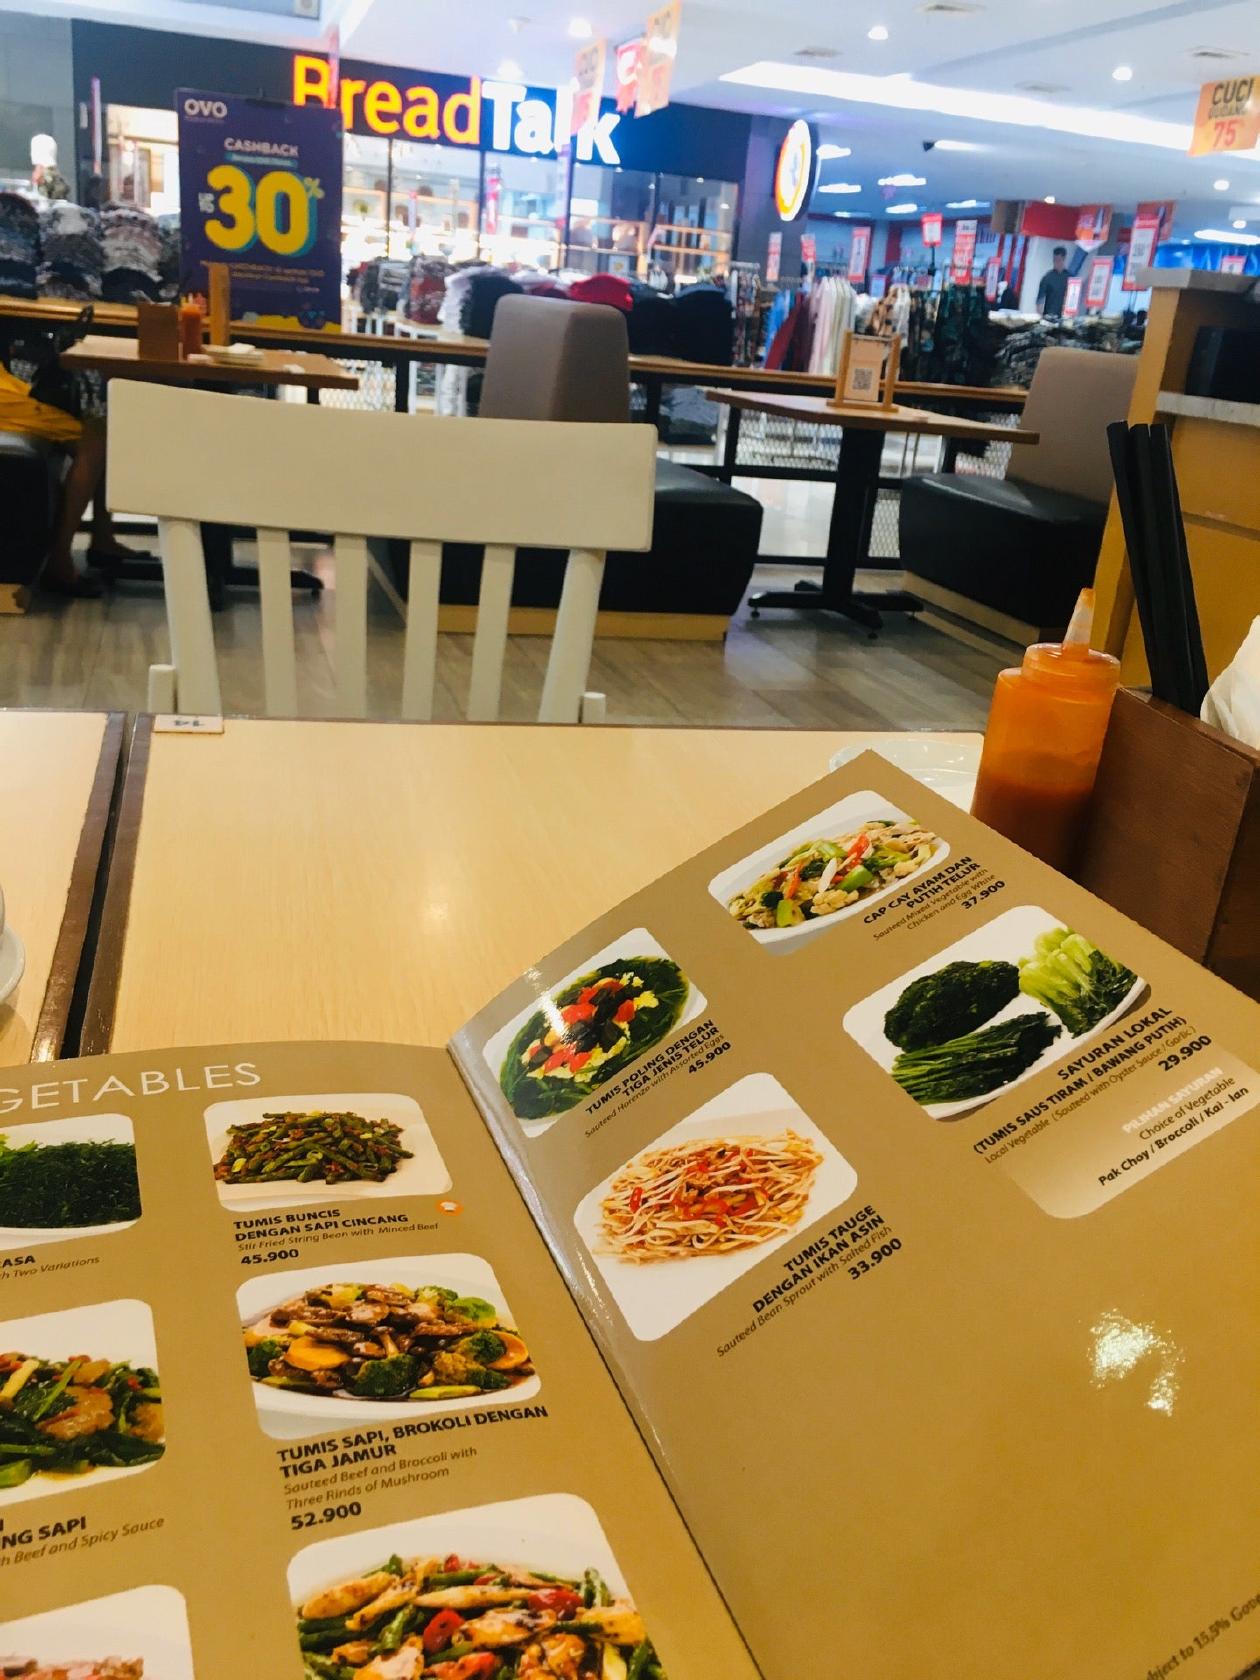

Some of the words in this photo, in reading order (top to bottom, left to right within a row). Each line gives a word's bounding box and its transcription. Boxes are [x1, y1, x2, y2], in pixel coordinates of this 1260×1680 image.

[184, 98, 228, 119] OVO
[1212, 78, 1254, 105] CUCI
[224, 137, 299, 157] CASHBACK
[864, 907, 887, 924] CAP
[888, 892, 911, 909] CAY
[912, 873, 945, 894] AYAM
[945, 856, 972, 874] DAN
[906, 885, 943, 908] PUTIH
[942, 863, 980, 887] TELUR
[961, 880, 1005, 910] 37.900
[622, 1075, 651, 1097] TIGA
[652, 1051, 683, 1076] JENIS
[682, 1026, 719, 1053] TELUR
[688, 1041, 731, 1073] 45.900
[1057, 1034, 1125, 1081] SAYURAN
[1123, 1008, 1172, 1039] LOKAL
[1158, 1035, 1212, 1071] 29.900
[585, 1085, 621, 1114] TUMIS
[622, 1054, 665, 1088] POLING
[665, 1019, 714, 1055] DENGAN
[973, 1122, 1018, 1154] (TUMIS
[1016, 1102, 1050, 1126] SAUS
[1046, 1078, 1088, 1105] TIRAM
[1092, 1041, 1145, 1077] BAWANG
[1143, 1016, 1187, 1045] PUTIH)
[0, 1063, 261, 1113] GETABLES
[1139, 1116, 1175, 1140] Choice
[1174, 1107, 1187, 1119] of
[1186, 1077, 1235, 1112] Vegetable
[984, 1145, 1009, 1164] Local
[1007, 1119, 1050, 1149] Vegetable
[1090, 1081, 1110, 1096] with
[1109, 1064, 1137, 1084] Oyster
[1098, 1168, 1121, 1186] Pak
[1121, 1149, 1150, 1171] Choy
[1155, 1116, 1200, 1149] Broccoli
[233, 1216, 282, 1229] TUMIS
[286, 1209, 341, 1223] BUNCIS
[235, 1225, 301, 1242] DENGAN
[304, 1220, 339, 1232] SAPI
[341, 1214, 408, 1228] CINCANG
[259, 1238, 285, 1249] Fried
[289, 1234, 320, 1244] String
[351, 1228, 374, 1237] with
[378, 1223, 415, 1234] Minced
[417, 1223, 439, 1231] Beef
[783, 1236, 829, 1272] TUMIS
[828, 1205, 876, 1240] TAUGE
[0, 1255, 36, 1269] ASA
[14, 1267, 38, 1278] Two
[40, 1256, 101, 1273] Variations
[241, 1249, 299, 1264] 45.900
[752, 1265, 813, 1313] DENGAN
[814, 1239, 850, 1268] IKAN
[850, 1214, 885, 1243] ASIN
[848, 1237, 902, 1280] 33.900
[716, 1319, 757, 1358] Sauteed
[757, 1304, 783, 1327] Bean
[783, 1278, 818, 1306] Sprout
[817, 1262, 839, 1282] with
[839, 1241, 872, 1266] Salted
[871, 1224, 892, 1244] Fish
[277, 1438, 339, 1463] TUMIS
[341, 1430, 390, 1450] SAPI,
[393, 1416, 471, 1440] BROKOLI
[475, 1405, 549, 1426] DENGAN
[279, 1458, 327, 1479] TIGA
[331, 1444, 397, 1468] JAMUR
[284, 1473, 337, 1495] Sauteed
[340, 1466, 369, 1482] Beef
[371, 1461, 396, 1475] and
[399, 1452, 448, 1469] Broccoli
[450, 1447, 477, 1460] with
[287, 1494, 323, 1510] Three
[364, 1480, 378, 1493] of
[381, 1468, 450, 1489] Mushroom
[38, 1516, 86, 1541] SAPI
[290, 1501, 362, 1530] 52.900
[14, 1544, 47, 1564] Beef
[48, 1537, 78, 1555] and
[81, 1529, 118, 1548] Spicy
[122, 1518, 165, 1537] Sauce
[1179, 1645, 1194, 1660] to
